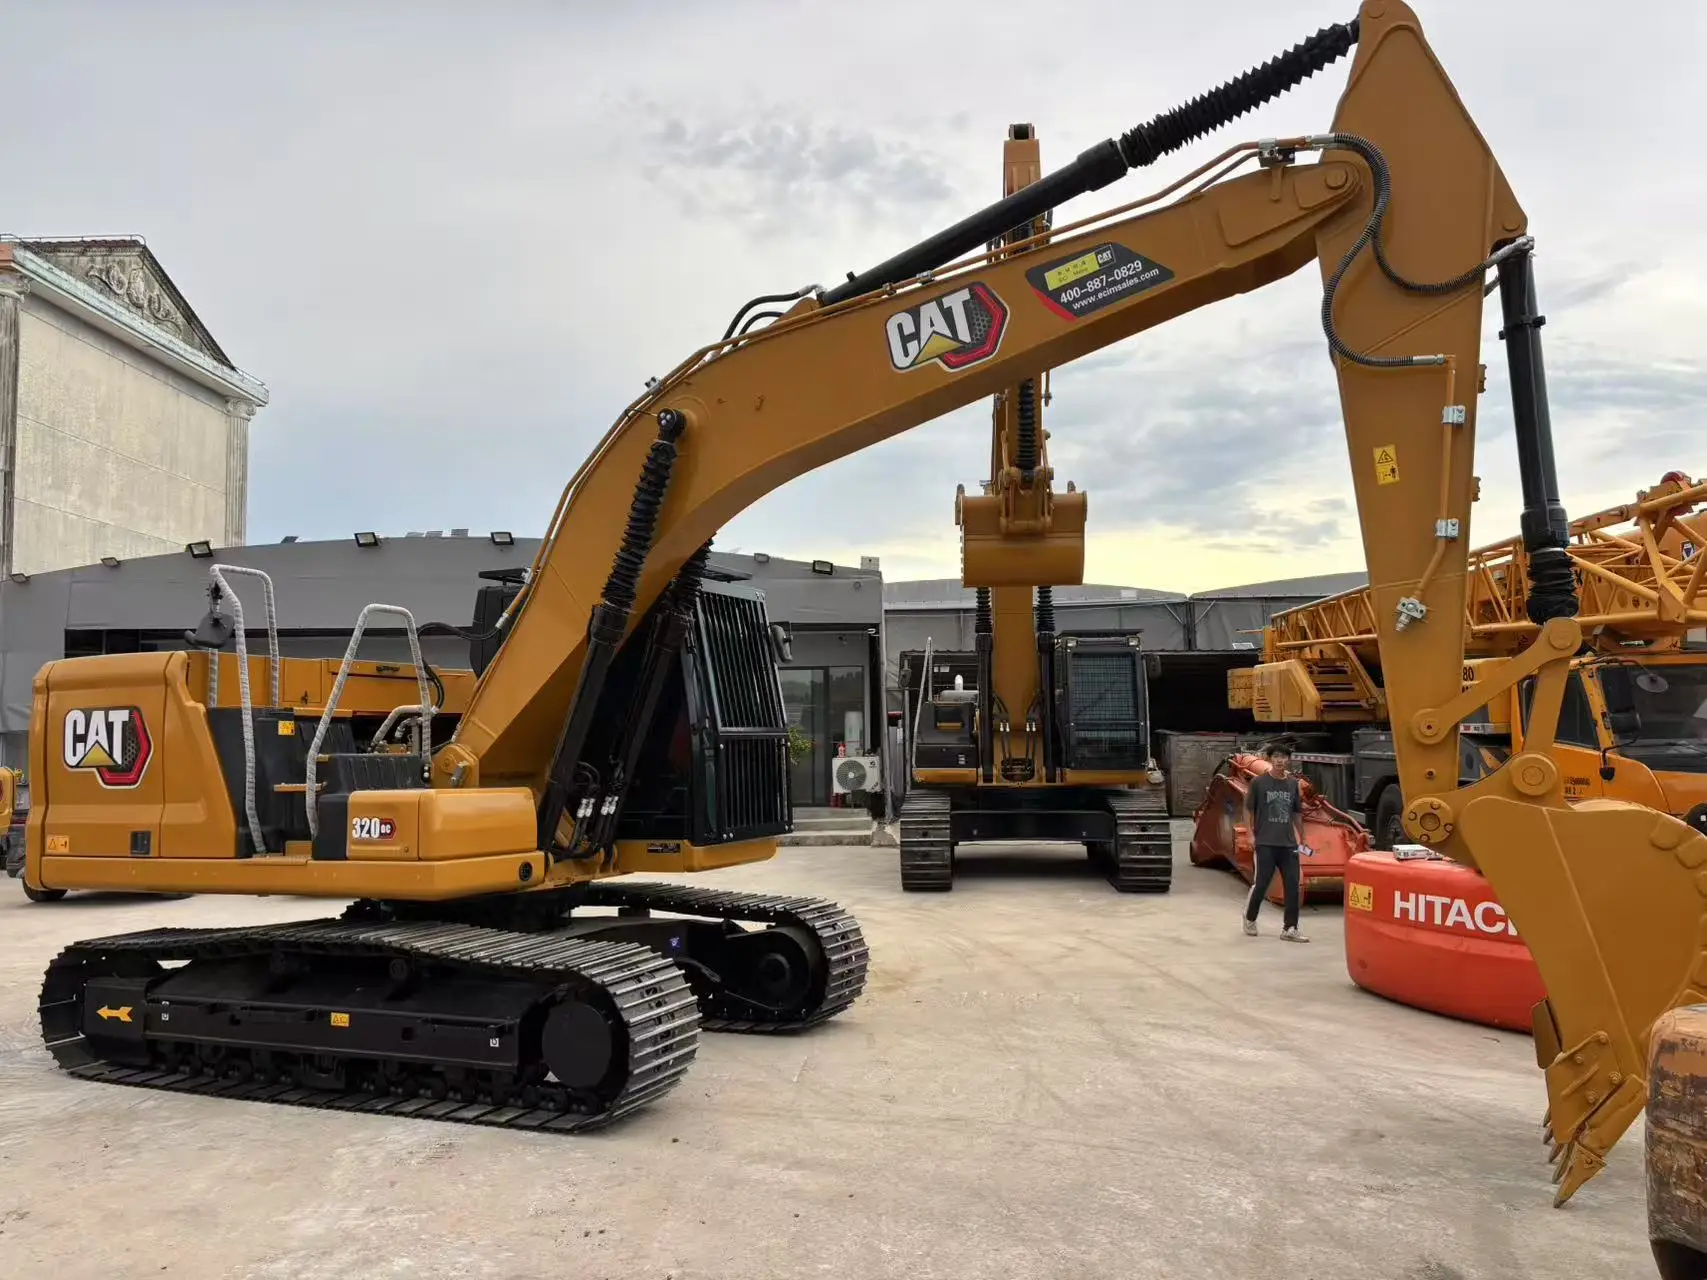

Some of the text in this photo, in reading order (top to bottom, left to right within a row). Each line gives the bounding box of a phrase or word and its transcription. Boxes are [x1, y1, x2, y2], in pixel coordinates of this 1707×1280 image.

[1097, 250, 1113, 263] CAT
[1060, 259, 1143, 304] 400-887-0829
[1072, 267, 1160, 310] www.ecimsales.com
[886, 288, 972, 368] CAT
[64, 709, 129, 766] CAT
[352, 817, 381, 839] 320
